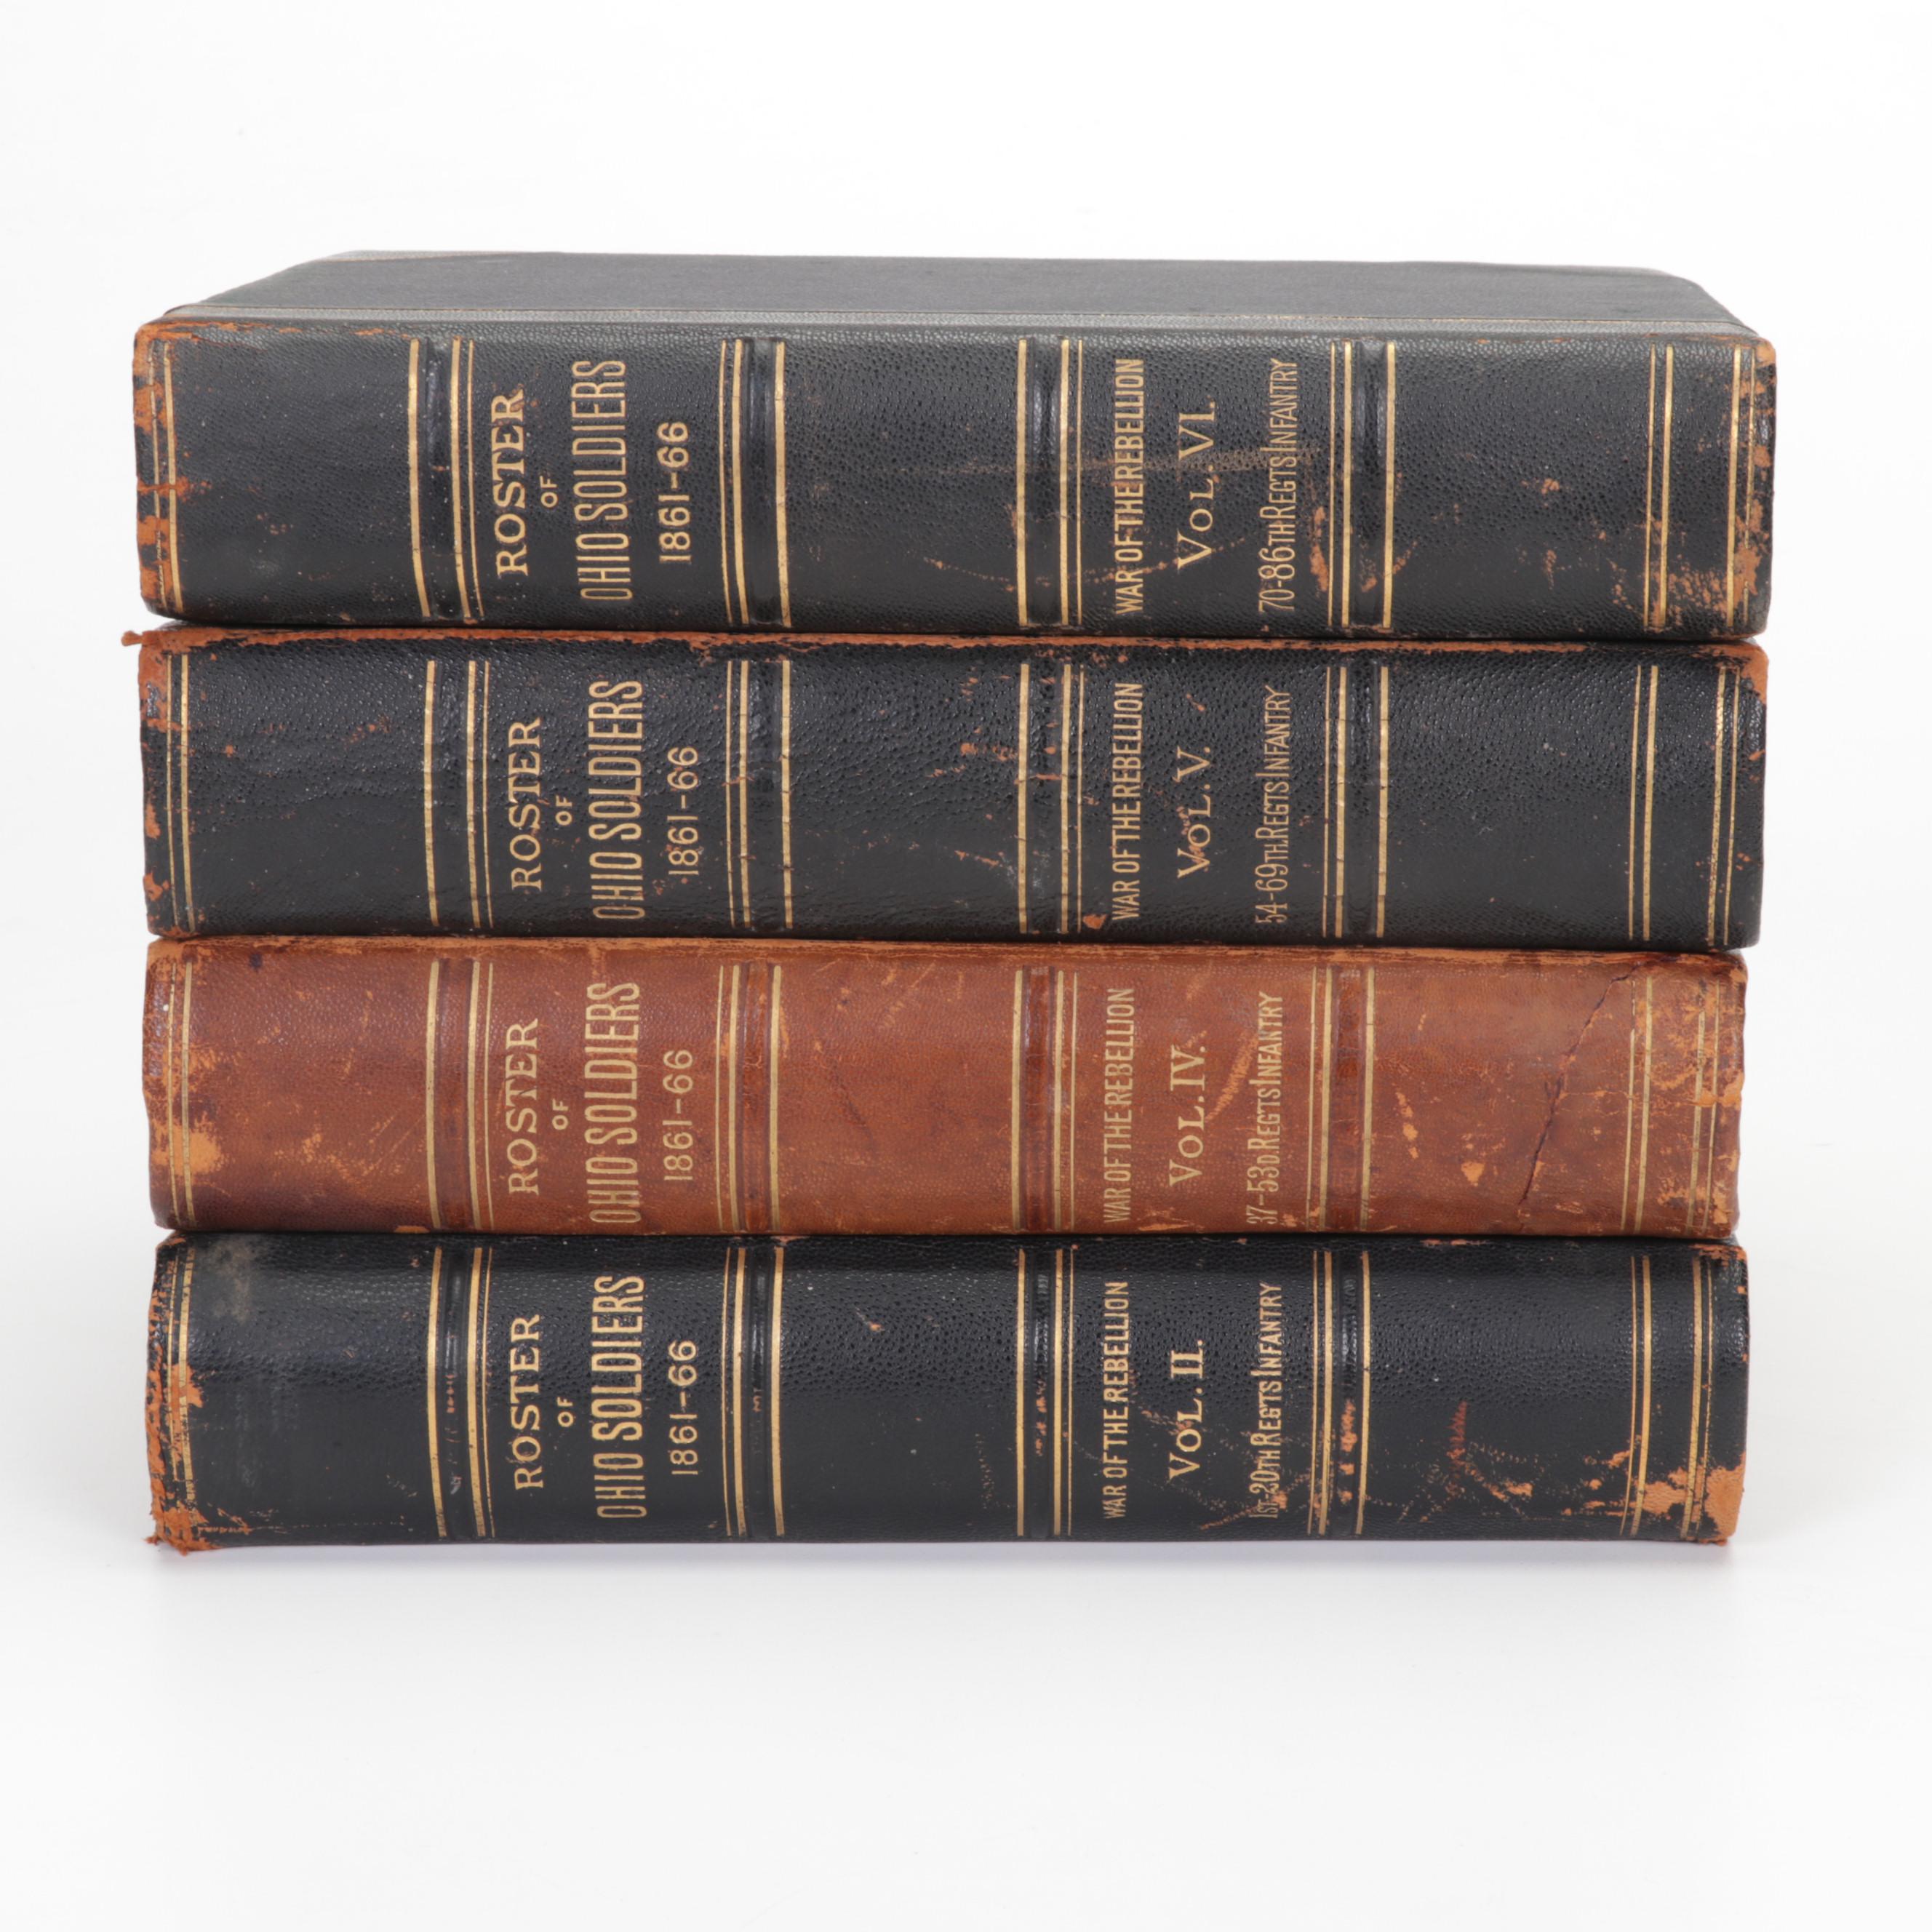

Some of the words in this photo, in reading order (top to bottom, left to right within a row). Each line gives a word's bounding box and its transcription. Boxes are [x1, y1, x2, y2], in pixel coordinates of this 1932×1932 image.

[1115, 359, 1143, 479] REBELLION
[1260, 357, 1298, 452] INFANTRY
[571, 360, 628, 521] SOLDIERS
[491, 389, 529, 576] ROSTER
[540, 476, 558, 508] OF
[656, 421, 691, 564] 1861-66
[1115, 484, 1143, 531] THE
[576, 534, 633, 600] OHIO
[1115, 534, 1143, 562] OF
[1116, 570, 1143, 614] WAR
[588, 681, 643, 840] SOLDIERS
[1112, 684, 1143, 797] REBELLION
[1173, 745, 1211, 782] V.
[1256, 685, 1290, 777] INFANTRY
[508, 718, 541, 890] ROSTER
[556, 796, 572, 826] OF
[667, 746, 699, 876] 1861-66
[1112, 802, 1141, 847] THE
[589, 852, 645, 919] OHIO
[1112, 848, 1141, 873] OF
[1112, 880, 1141, 919] WAR
[584, 983, 640, 1144] SOLDIERS
[1104, 989, 1135, 1106] REBELLION
[1170, 1045, 1205, 1092] IV.
[1249, 991, 1282, 1085] INFANTRY
[506, 1019, 539, 1194] ROSTER
[552, 1098, 568, 1130] OF
[662, 1050, 694, 1181] 1861-66
[1104, 1110, 1132, 1154] THE
[586, 1157, 642, 1224] OHIO
[1104, 1156, 1131, 1181] OF
[1103, 1188, 1131, 1222] WAR
[591, 1276, 644, 1440] SOLDIERS
[1103, 1282, 1130, 1402] REBELLION
[1171, 1340, 1204, 1378] II.
[1251, 1282, 1283, 1376] INFANTRY
[510, 1314, 543, 1489] ROSTER
[557, 1397, 574, 1427] OF
[668, 1340, 699, 1475] 1861-66
[1103, 1407, 1128, 1453] THE
[593, 1453, 647, 1518] OHIO
[1103, 1455, 1127, 1478] OF
[1103, 1485, 1127, 1518] WAR
